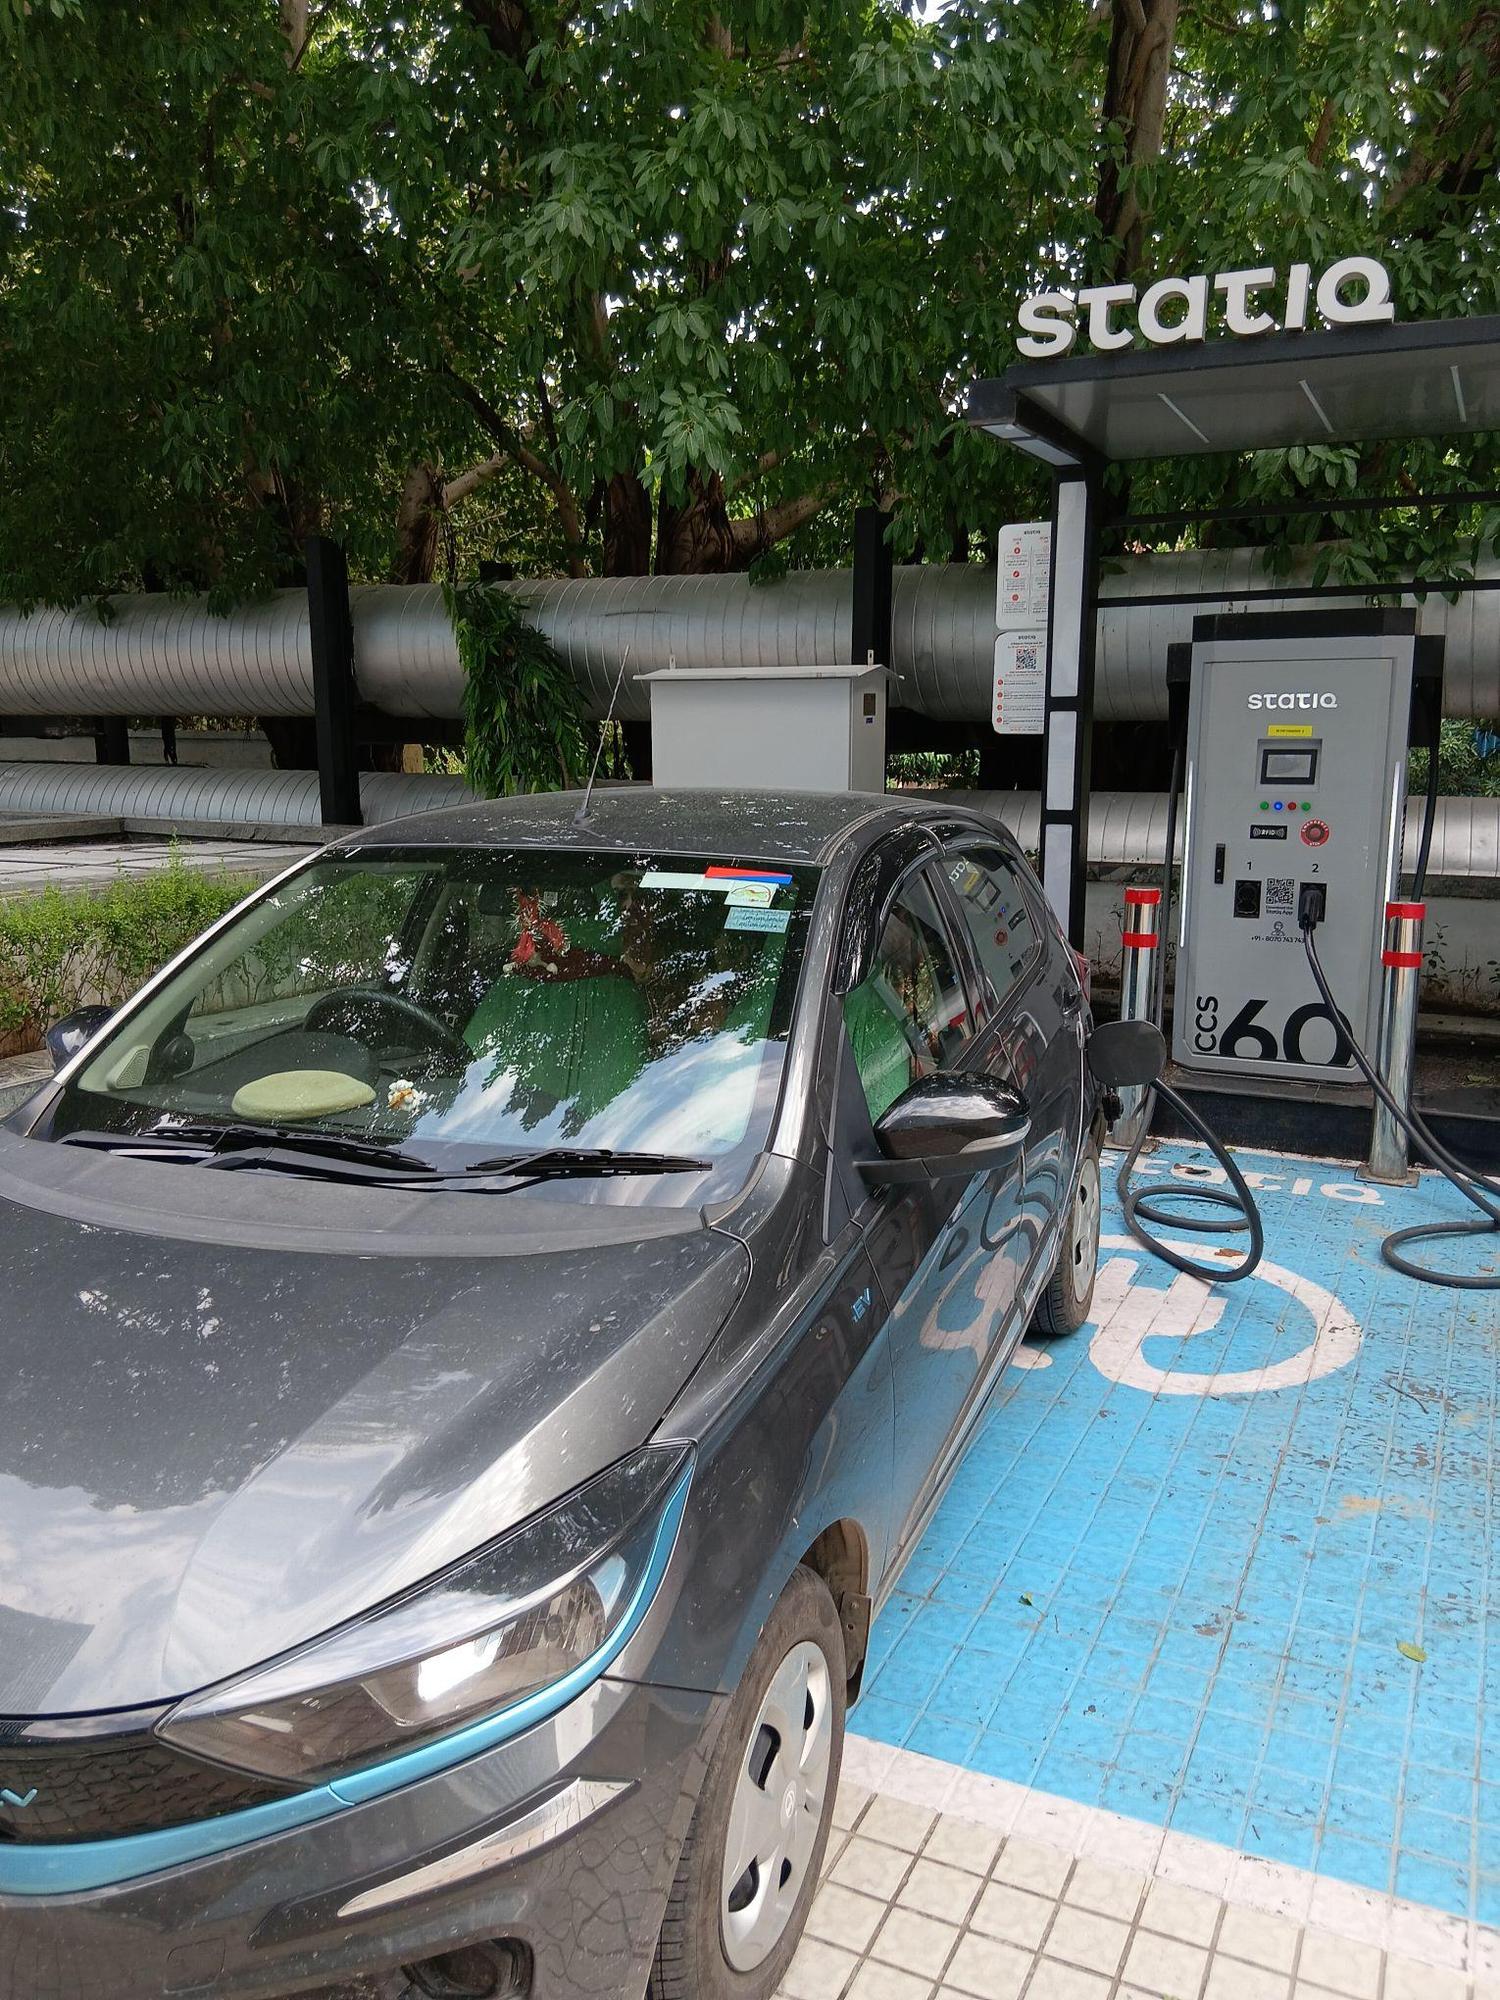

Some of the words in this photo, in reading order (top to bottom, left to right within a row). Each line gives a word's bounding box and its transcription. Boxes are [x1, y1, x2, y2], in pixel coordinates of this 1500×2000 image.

[1247, 861, 1252, 871] 1
[1311, 863, 1319, 873] 2
[1194, 996, 1219, 1052] CCS
[1219, 999, 1354, 1067] 60
